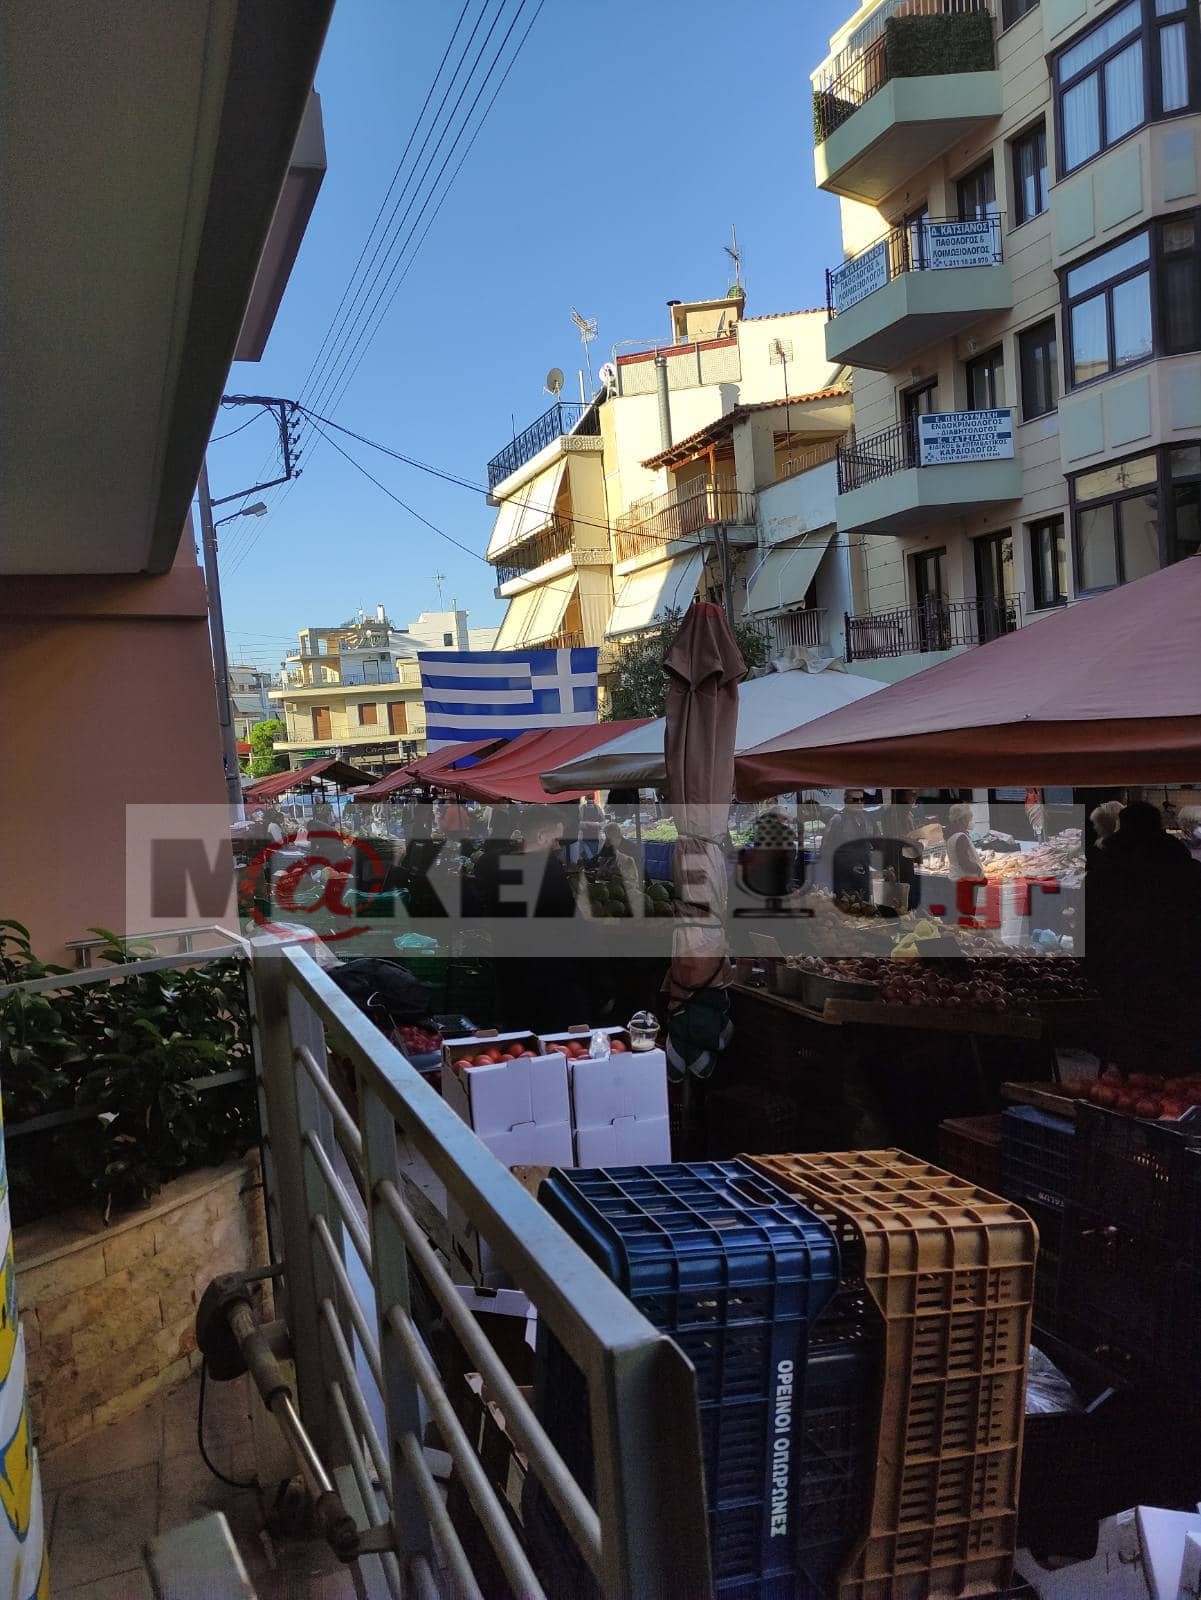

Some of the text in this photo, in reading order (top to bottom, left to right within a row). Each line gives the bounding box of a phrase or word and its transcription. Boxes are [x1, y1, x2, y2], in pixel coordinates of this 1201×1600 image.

[940, 222, 988, 235] ΚΑΤΣΙΑΝΟΣ
[936, 236, 978, 247] ΠΑΘΟΛΟΓΟΣ
[933, 246, 990, 258] ΛΟΙΜΩΞΙΟΛΟΓΟΣ
[931, 419, 1003, 430] ΕΝΔΟΚΡΙΝΟΛΟΓΟΣ
[941, 426, 997, 436] ΔΙΑΒΗΤΟΛΟΓΟΣ
[940, 446, 997, 456] ΚΑΡΔΙΟΛΟΓΟΣ
[775, 1359, 794, 1433] ΟΡΕΙΝΟΙ
